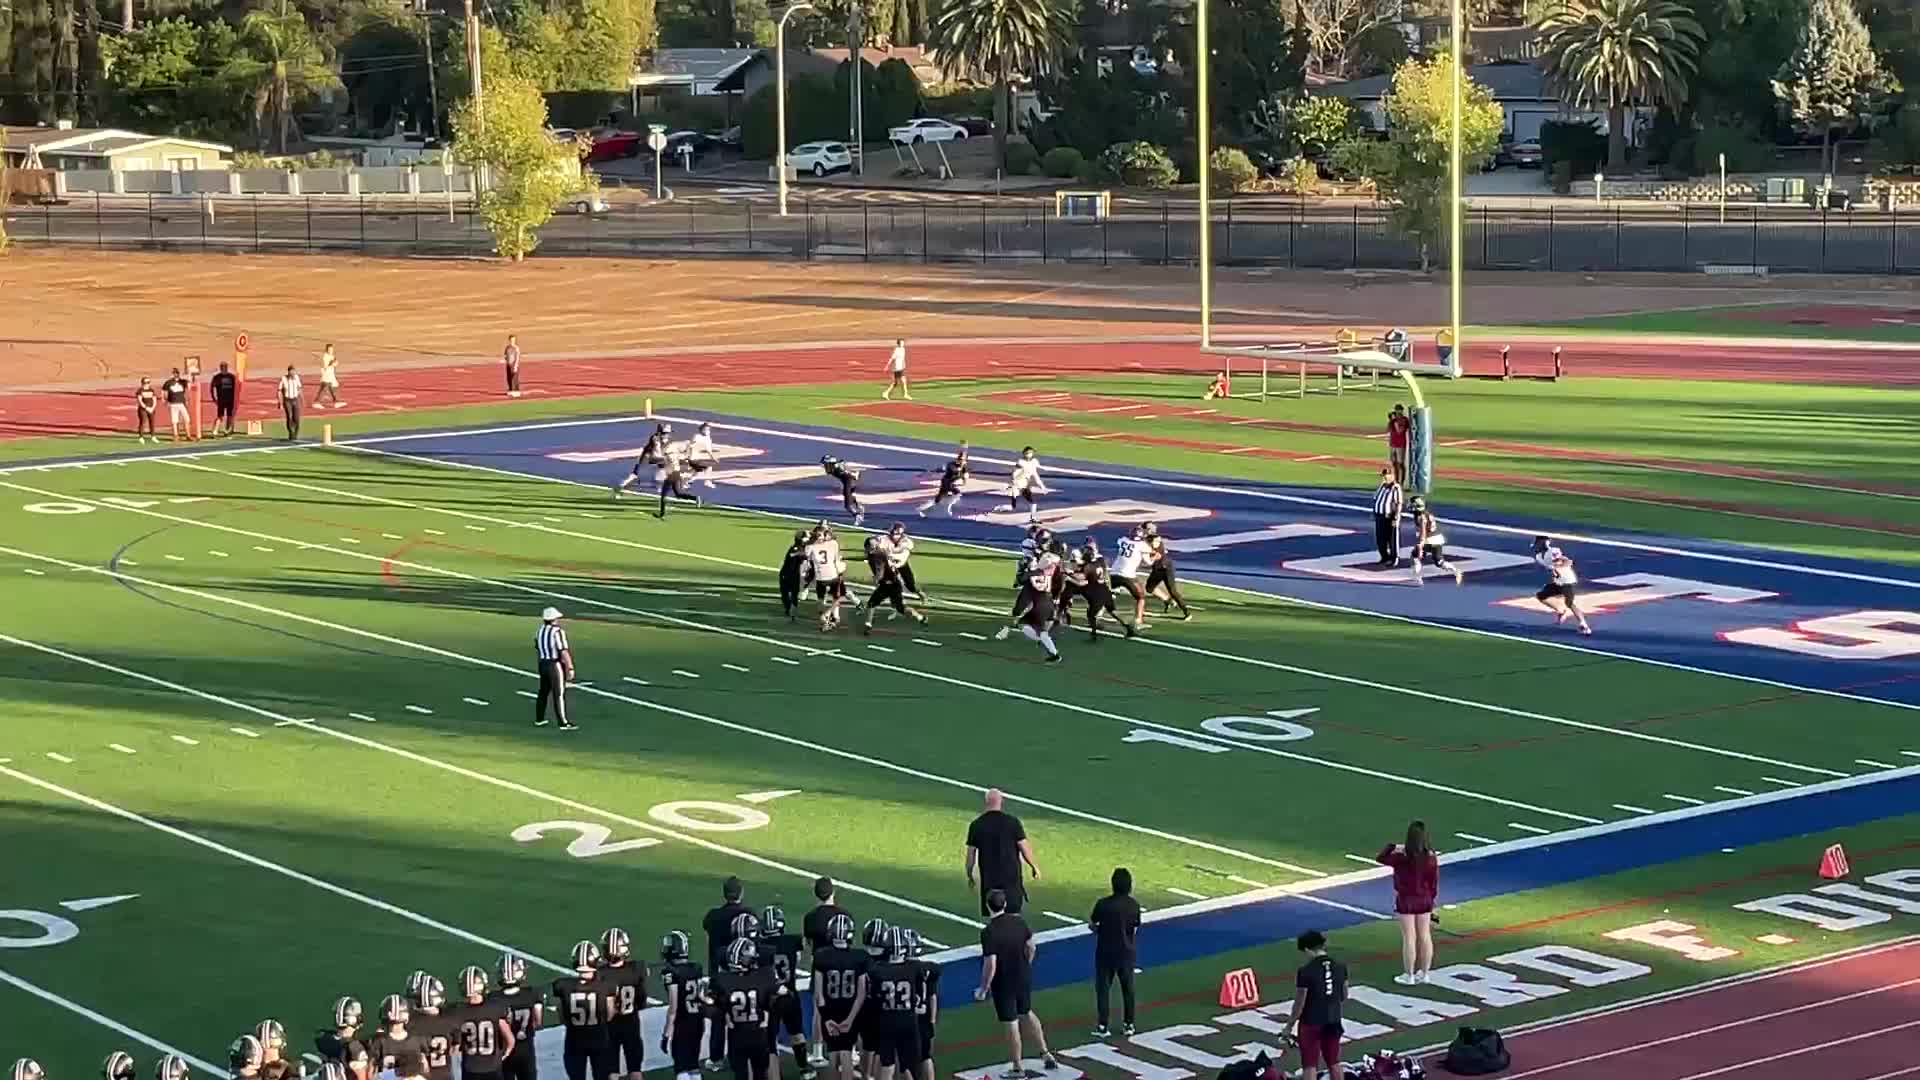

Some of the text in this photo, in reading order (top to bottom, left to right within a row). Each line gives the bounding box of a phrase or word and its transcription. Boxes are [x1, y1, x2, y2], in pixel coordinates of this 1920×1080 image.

[818, 550, 829, 565] 3
[1121, 715, 1315, 754] 10
[510, 800, 771, 858] 20
[616, 984, 636, 1015] 8
[1230, 971, 1256, 1005] 20
[569, 991, 599, 1027] 51
[730, 989, 759, 1023] 21
[460, 1019, 495, 1056] 30
